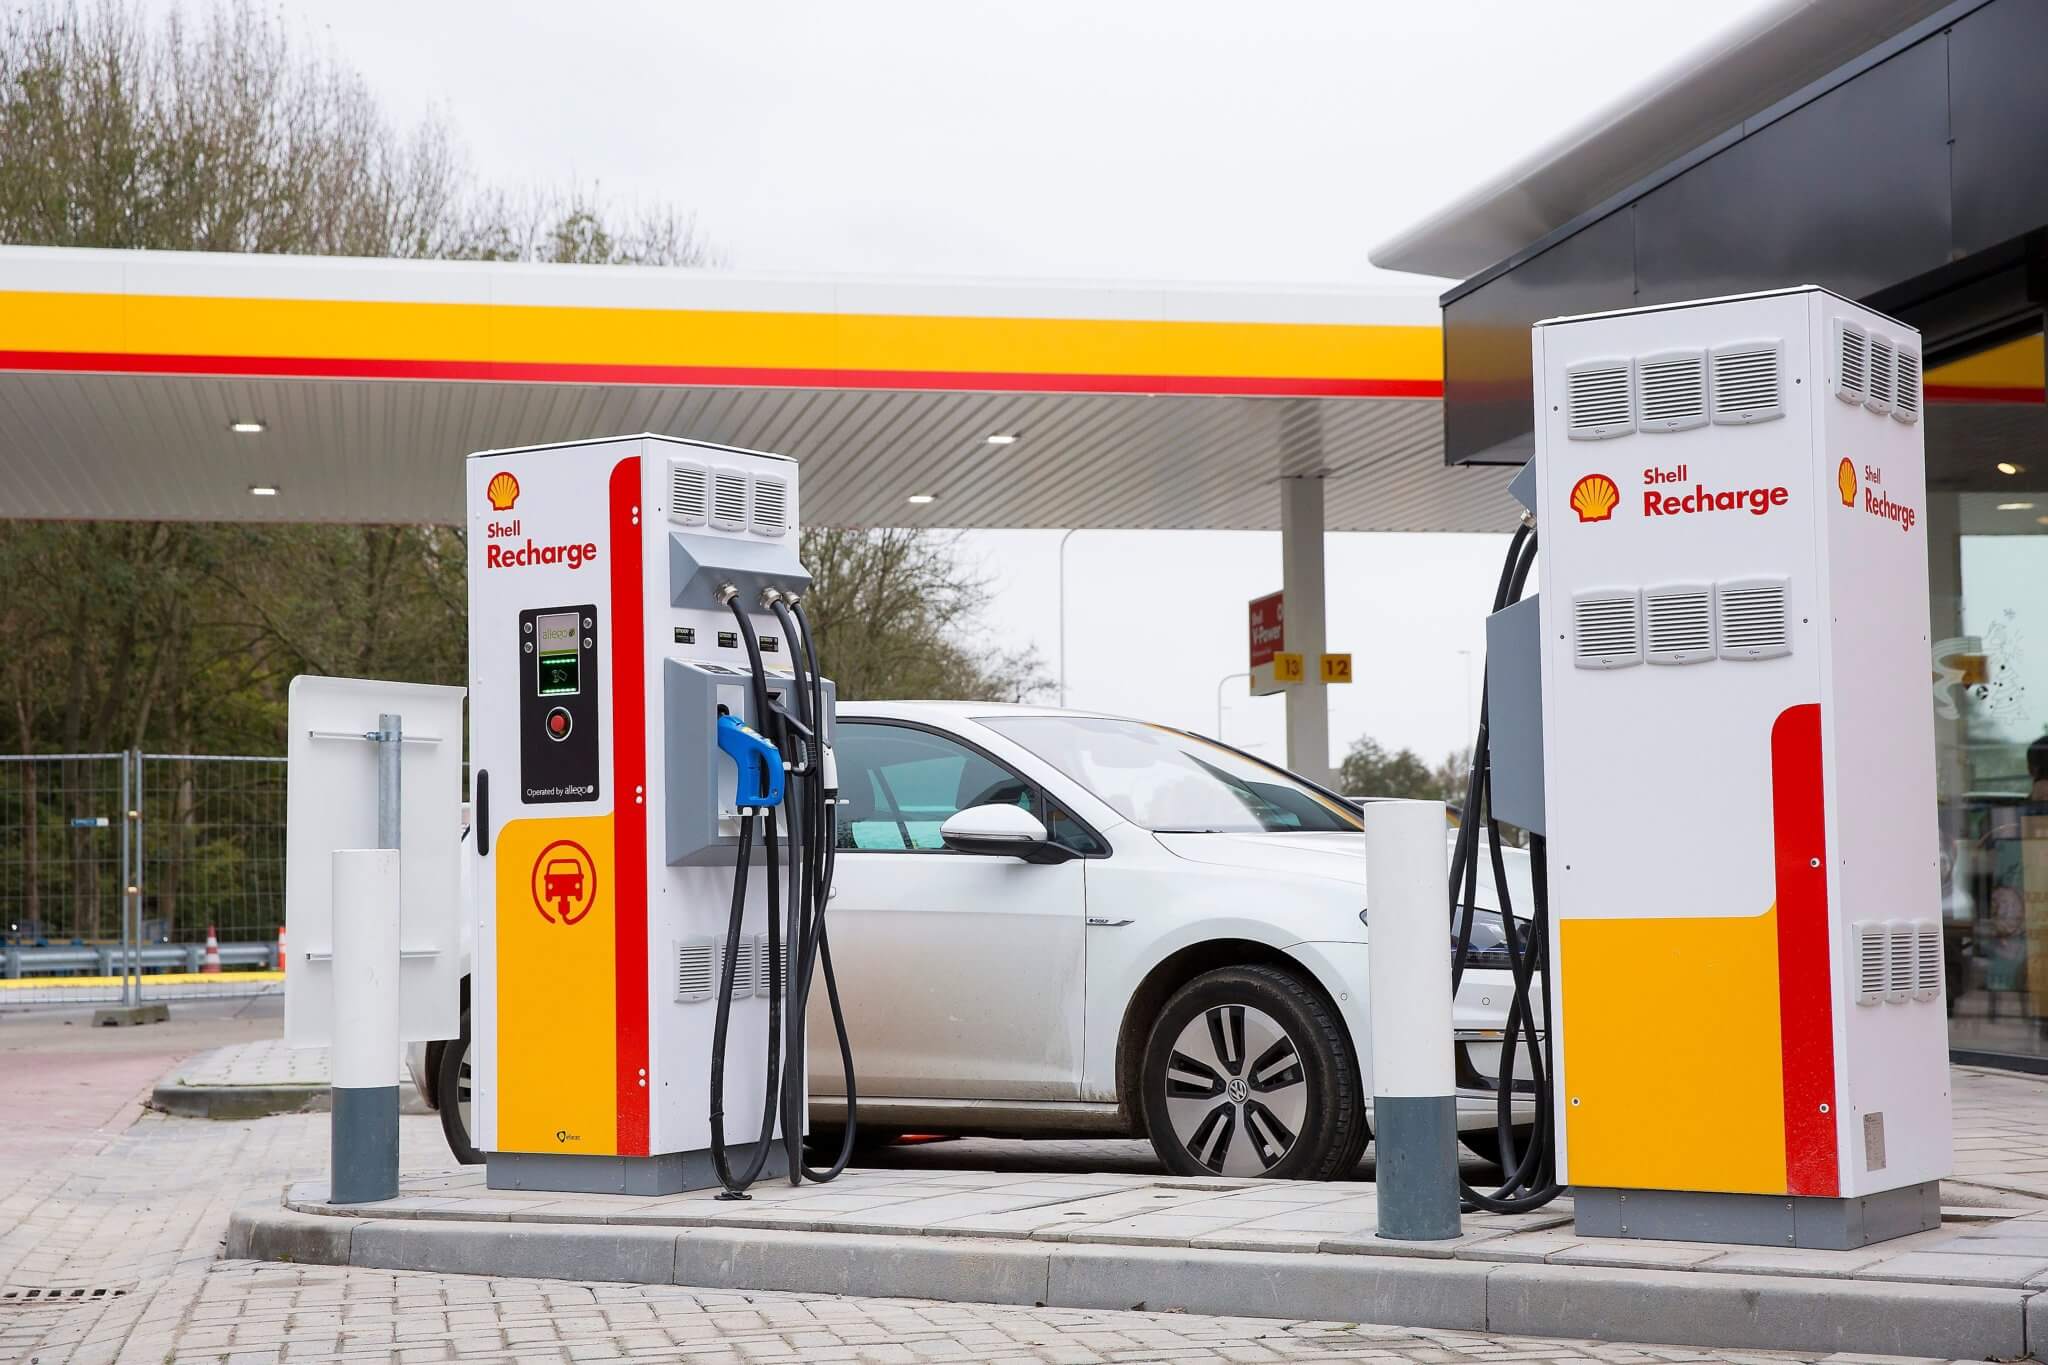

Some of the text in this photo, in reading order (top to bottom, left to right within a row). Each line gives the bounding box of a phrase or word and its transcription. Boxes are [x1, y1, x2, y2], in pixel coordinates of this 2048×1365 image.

[1644, 465, 1687, 484] Shell
[1865, 465, 1881, 484] Shell
[1644, 484, 1789, 516] Recharge
[1865, 487, 1915, 532] Recharge
[487, 519, 520, 538] Shell
[487, 538, 597, 570] Recharge
[543, 627, 568, 641] allego
[1285, 659, 1300, 676] 13
[1326, 660, 1348, 676] 12
[526, 784, 587, 798] Operated by allego
